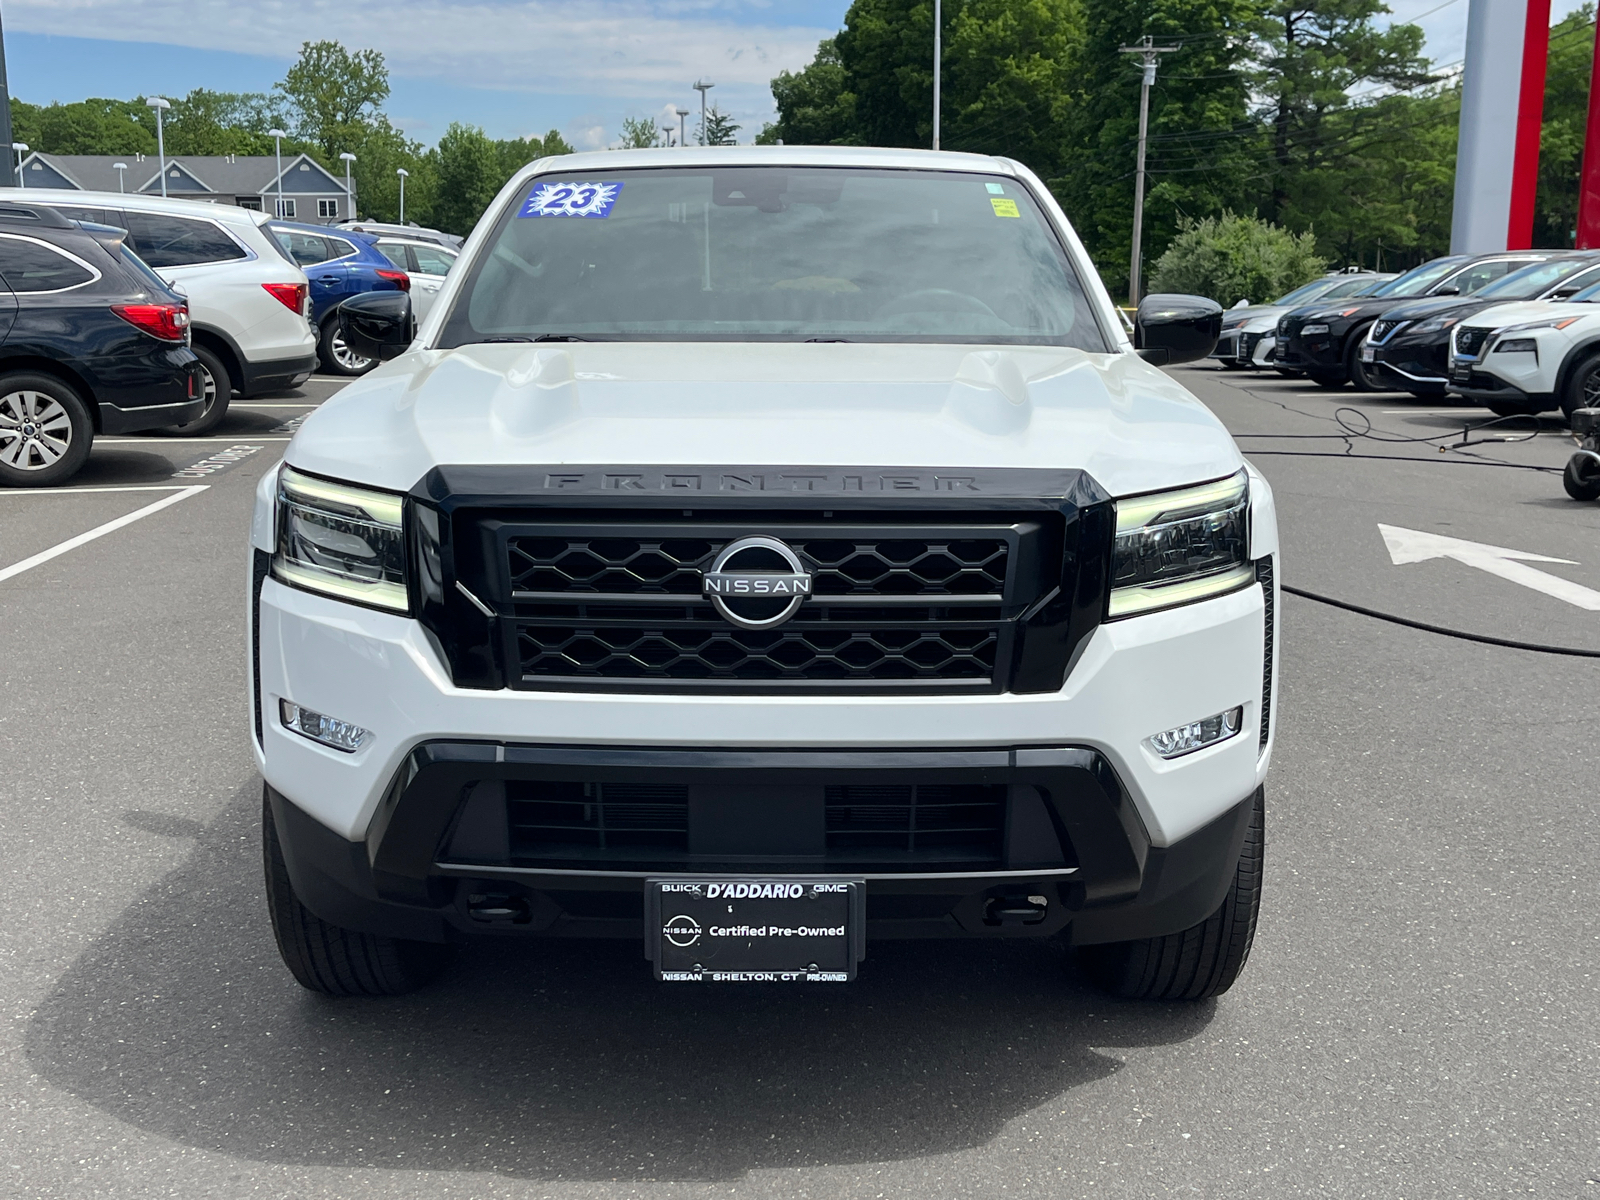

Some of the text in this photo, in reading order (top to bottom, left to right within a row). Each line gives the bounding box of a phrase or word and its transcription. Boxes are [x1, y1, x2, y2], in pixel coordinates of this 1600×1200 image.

[543, 187, 599, 209] 23
[544, 473, 982, 492] FRONTIER
[705, 577, 812, 593] NISSAN
[662, 884, 702, 893] BUICK
[706, 883, 804, 899] D'ADDARIO
[813, 884, 848, 893] GMC
[709, 925, 845, 937] Certified Pre-Owned
[662, 973, 702, 981] NISSAN
[712, 973, 799, 982] SHELTON, CT
[806, 974, 848, 982] PRE-OWNED
